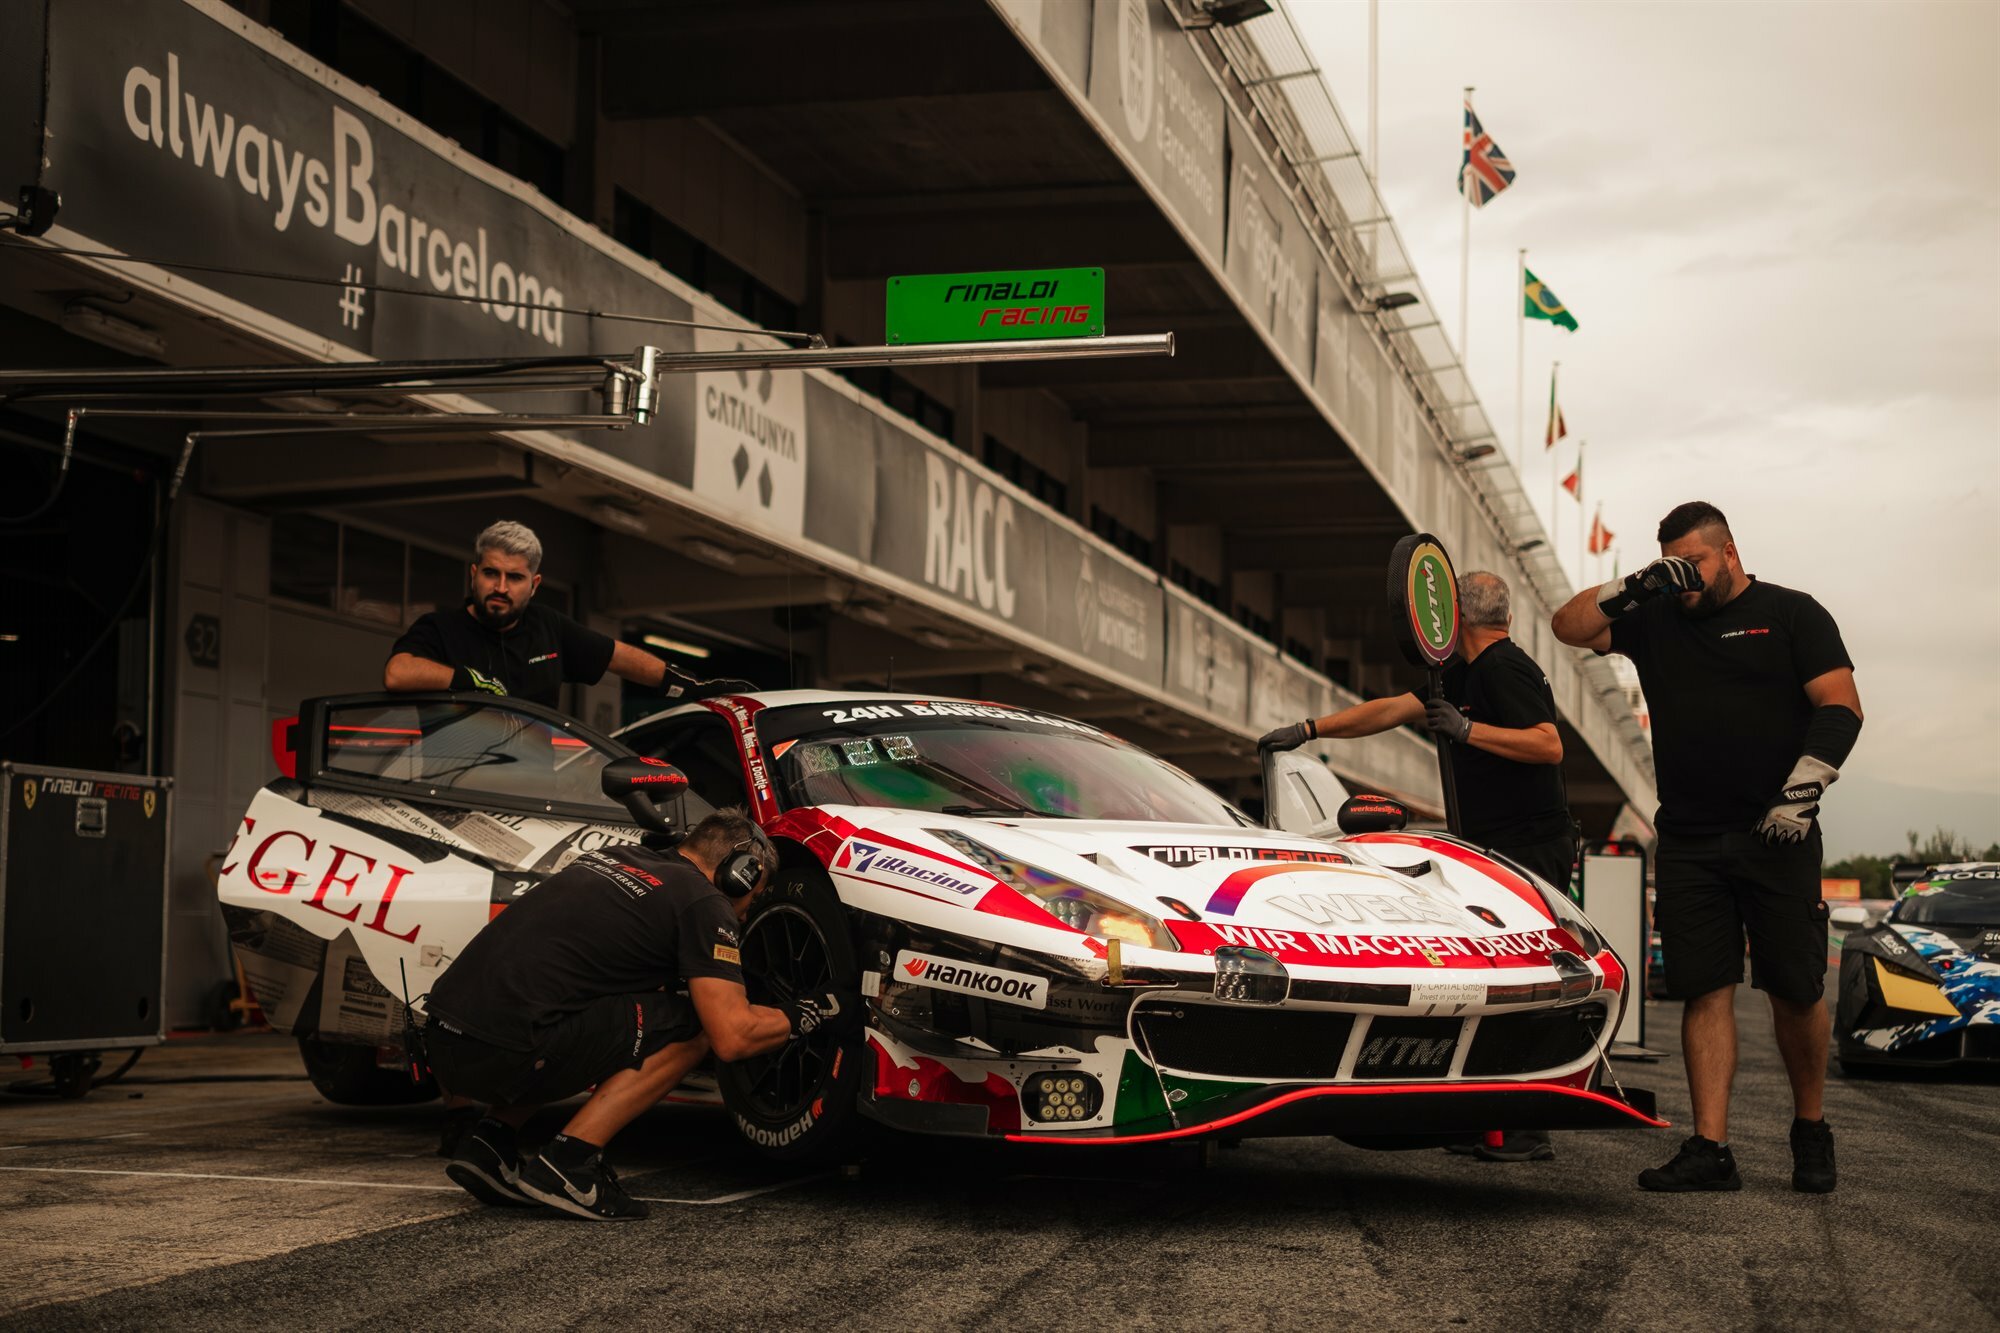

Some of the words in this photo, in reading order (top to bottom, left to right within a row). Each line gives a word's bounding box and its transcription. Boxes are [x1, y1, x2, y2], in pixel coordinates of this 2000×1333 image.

[338, 262, 366, 331] #
[704, 384, 798, 464] CATALUNYA
[923, 450, 1017, 619] RACC
[1423, 560, 1444, 644] WTM
[822, 705, 903, 725] 24H
[751, 765, 768, 790] Dontje
[409, 813, 429, 831] den
[612, 871, 648, 898] FERRARI
[873, 855, 980, 896] iRacing
[1207, 923, 1306, 953] WIR
[1306, 931, 1472, 957] MACHEN
[1470, 929, 1562, 958] DRUCK
[1419, 992, 1440, 1001] Invest
[1439, 993, 1446, 1001] in
[1445, 994, 1462, 1003] your
[1461, 992, 1479, 1001] future
